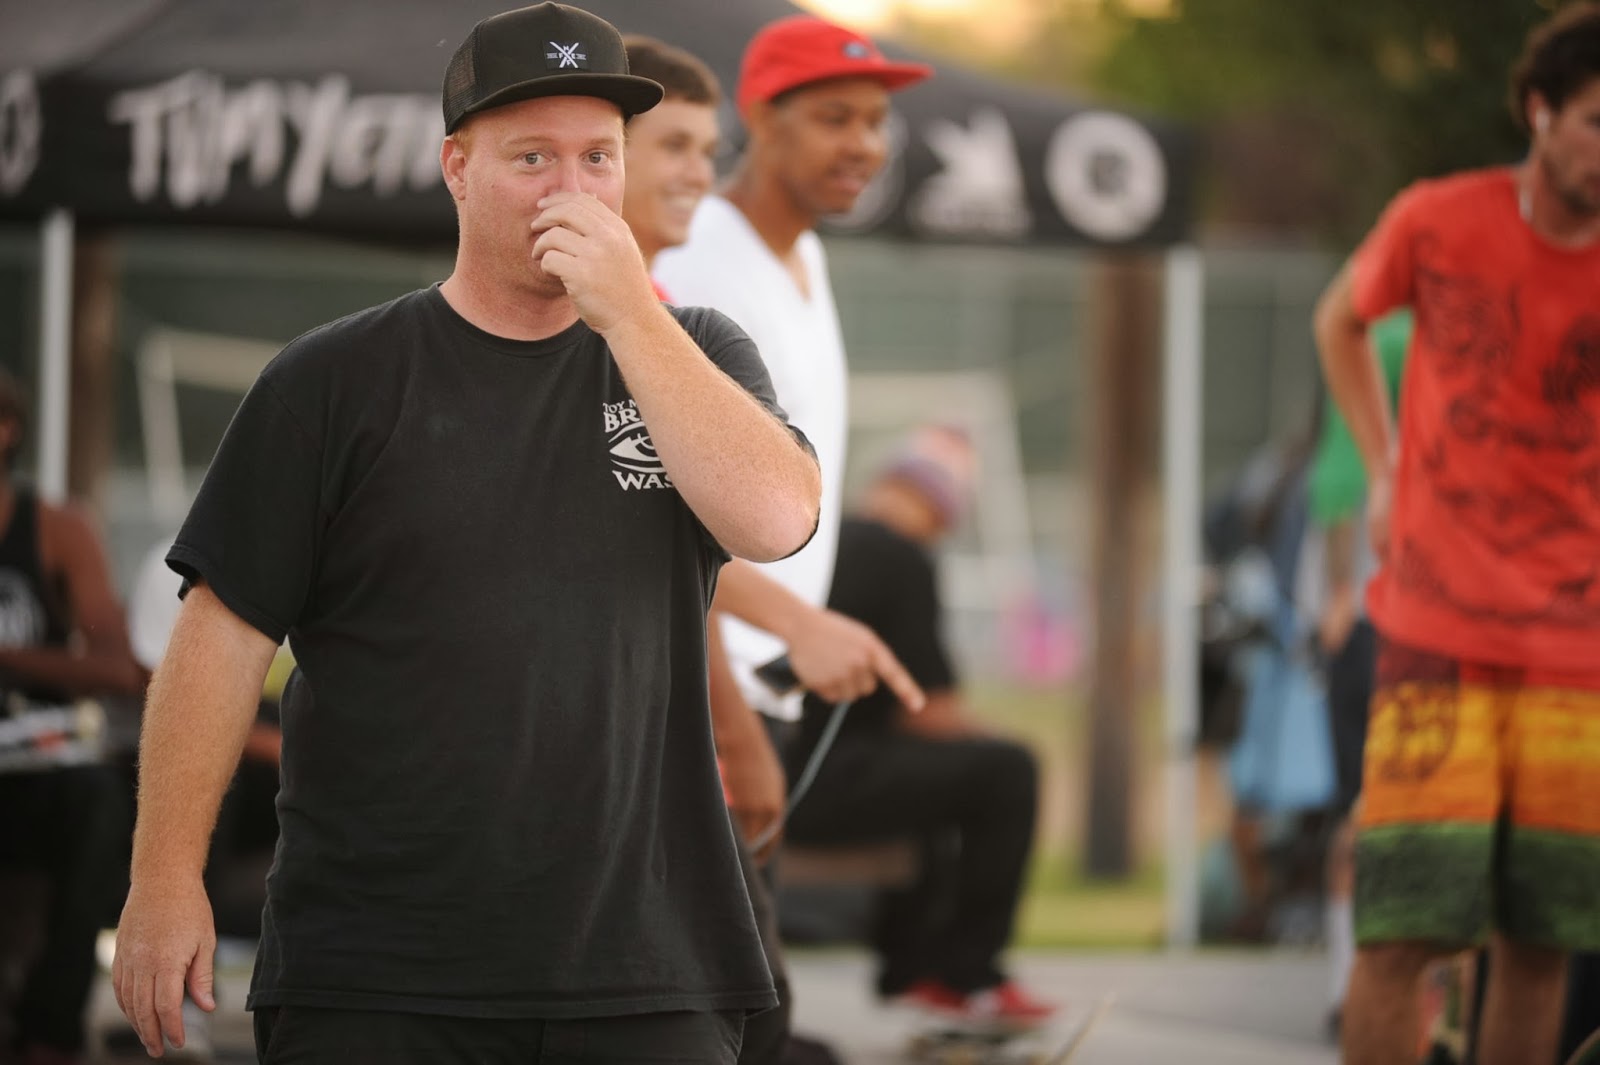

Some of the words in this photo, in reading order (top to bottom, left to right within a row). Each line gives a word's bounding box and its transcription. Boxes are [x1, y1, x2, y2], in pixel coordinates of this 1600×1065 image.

[602, 400, 626, 414] TOY
[603, 408, 641, 433] BR
[612, 469, 674, 491] WAS
